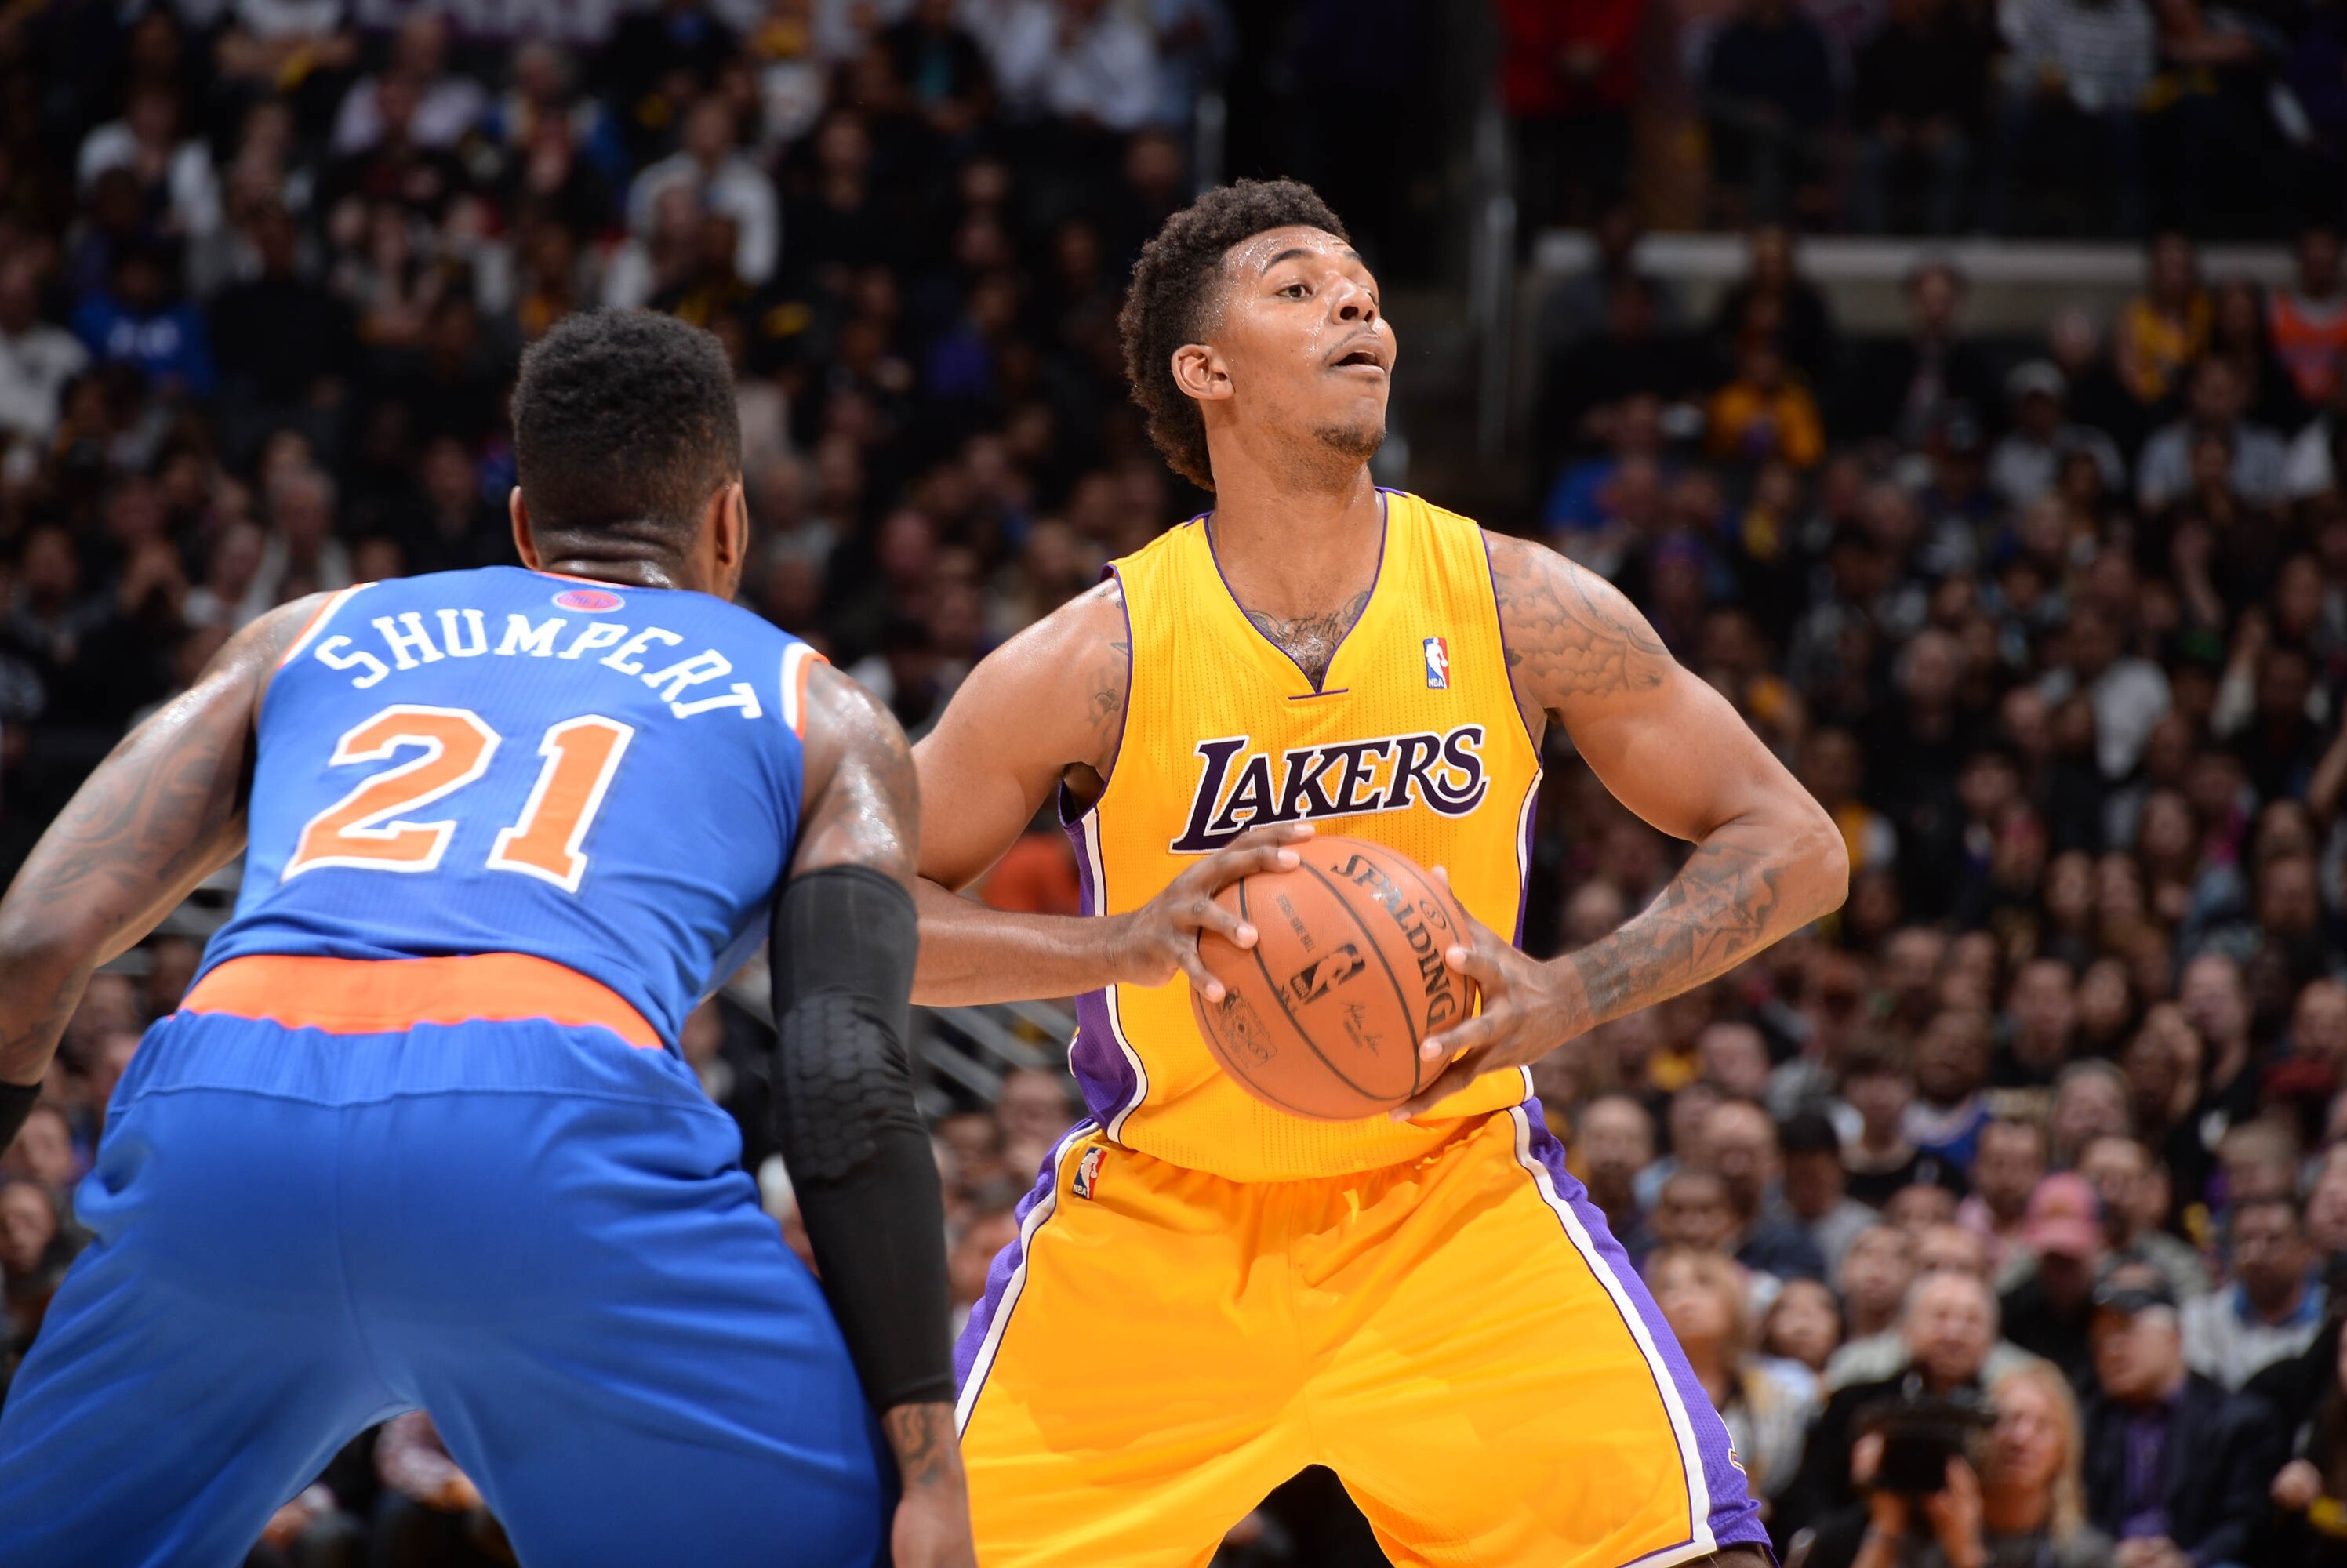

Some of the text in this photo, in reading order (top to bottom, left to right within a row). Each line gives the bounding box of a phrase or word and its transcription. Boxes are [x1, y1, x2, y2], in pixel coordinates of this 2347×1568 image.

[314, 608, 763, 720] SHUMPERT
[1428, 678, 1444, 687] NBA
[280, 703, 634, 895] 21
[1168, 723, 1491, 855] LAKERS
[1292, 978, 1308, 999] NBA
[1330, 854, 1457, 1029] SPALDING
[1073, 1184, 1087, 1196] NBA
